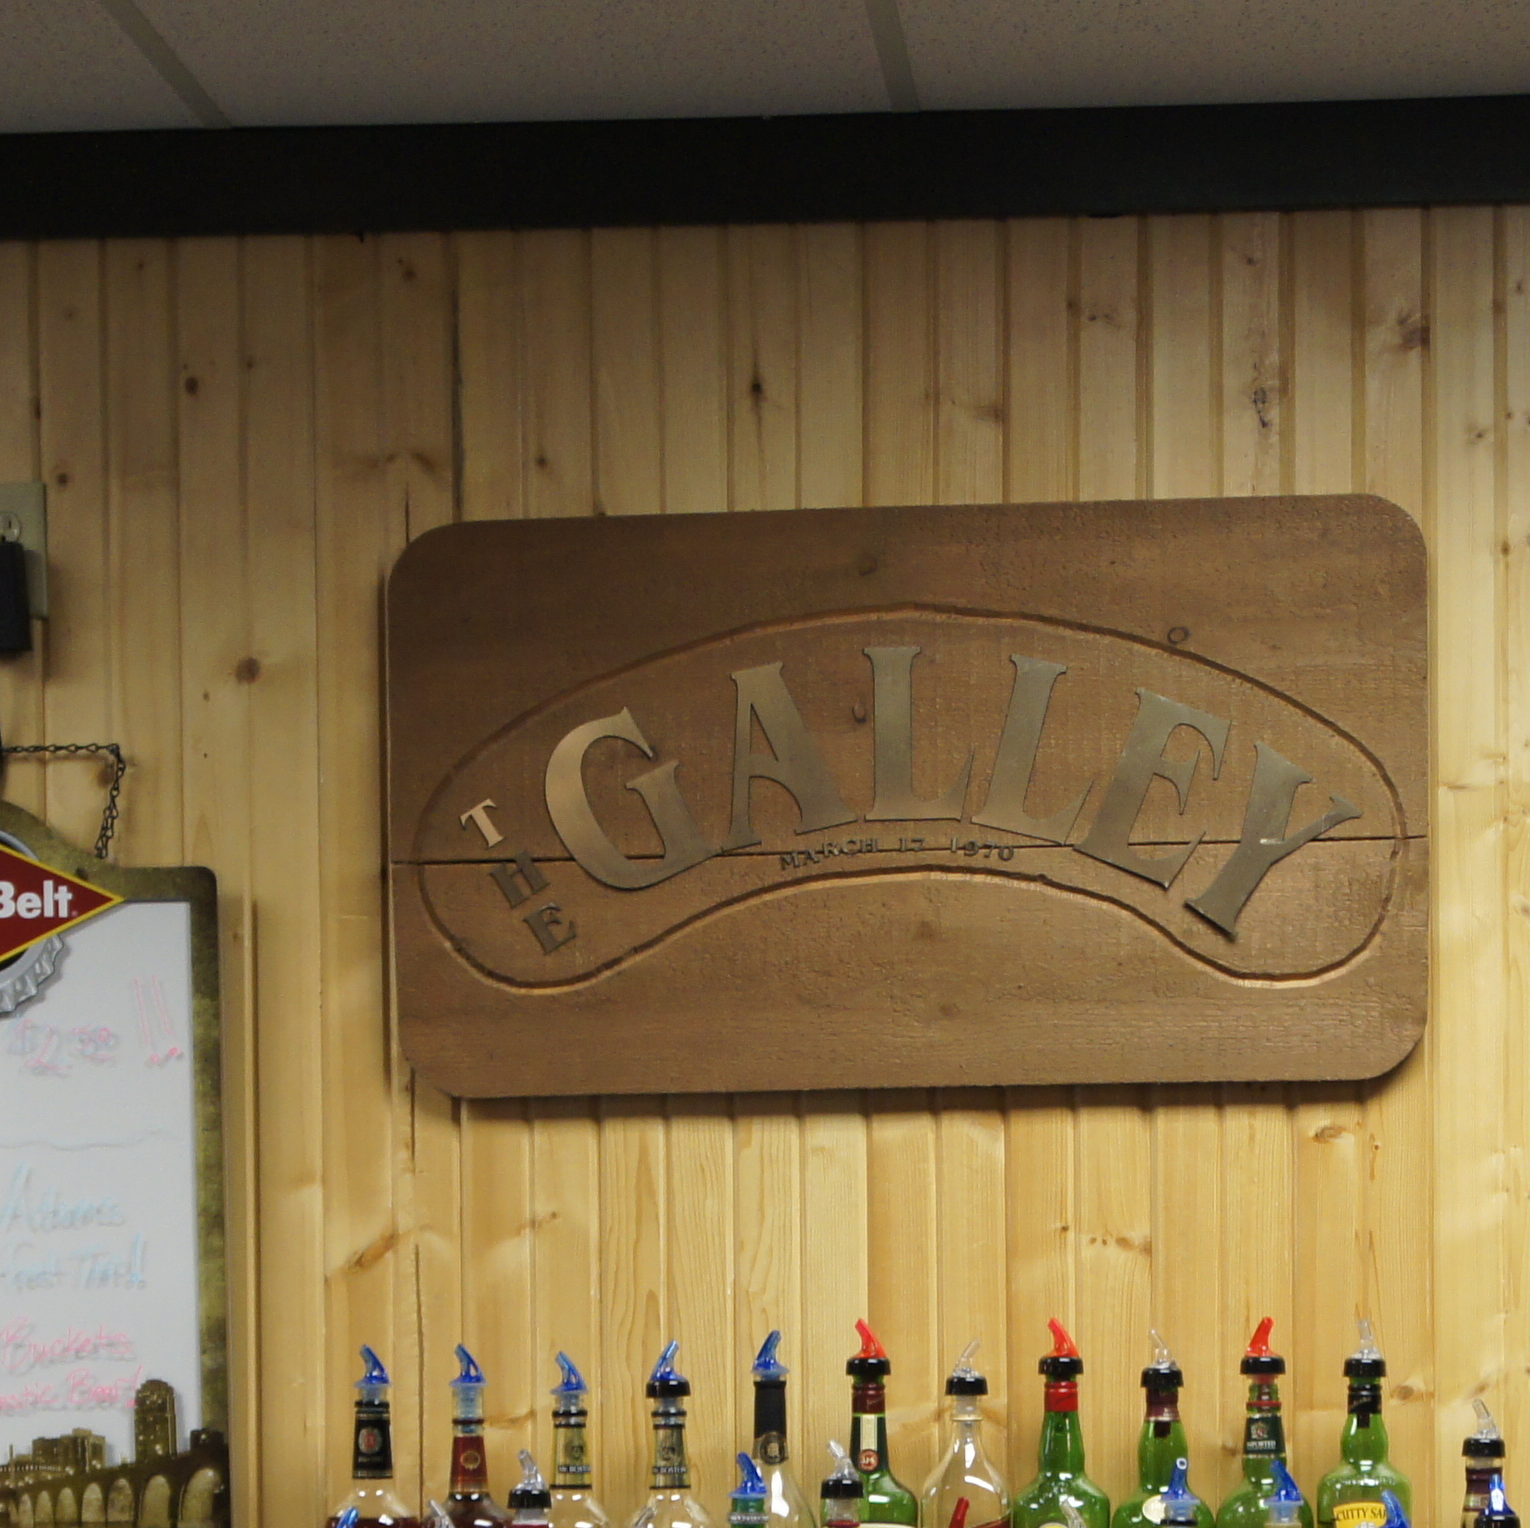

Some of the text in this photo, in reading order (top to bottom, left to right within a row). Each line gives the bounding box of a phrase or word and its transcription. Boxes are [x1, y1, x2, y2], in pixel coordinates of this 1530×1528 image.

[460, 646, 1364, 955] THE GALLEY
[780, 837, 1015, 870] MARCH 17 1970
[1336, 1507, 1366, 1520] CUTTY
